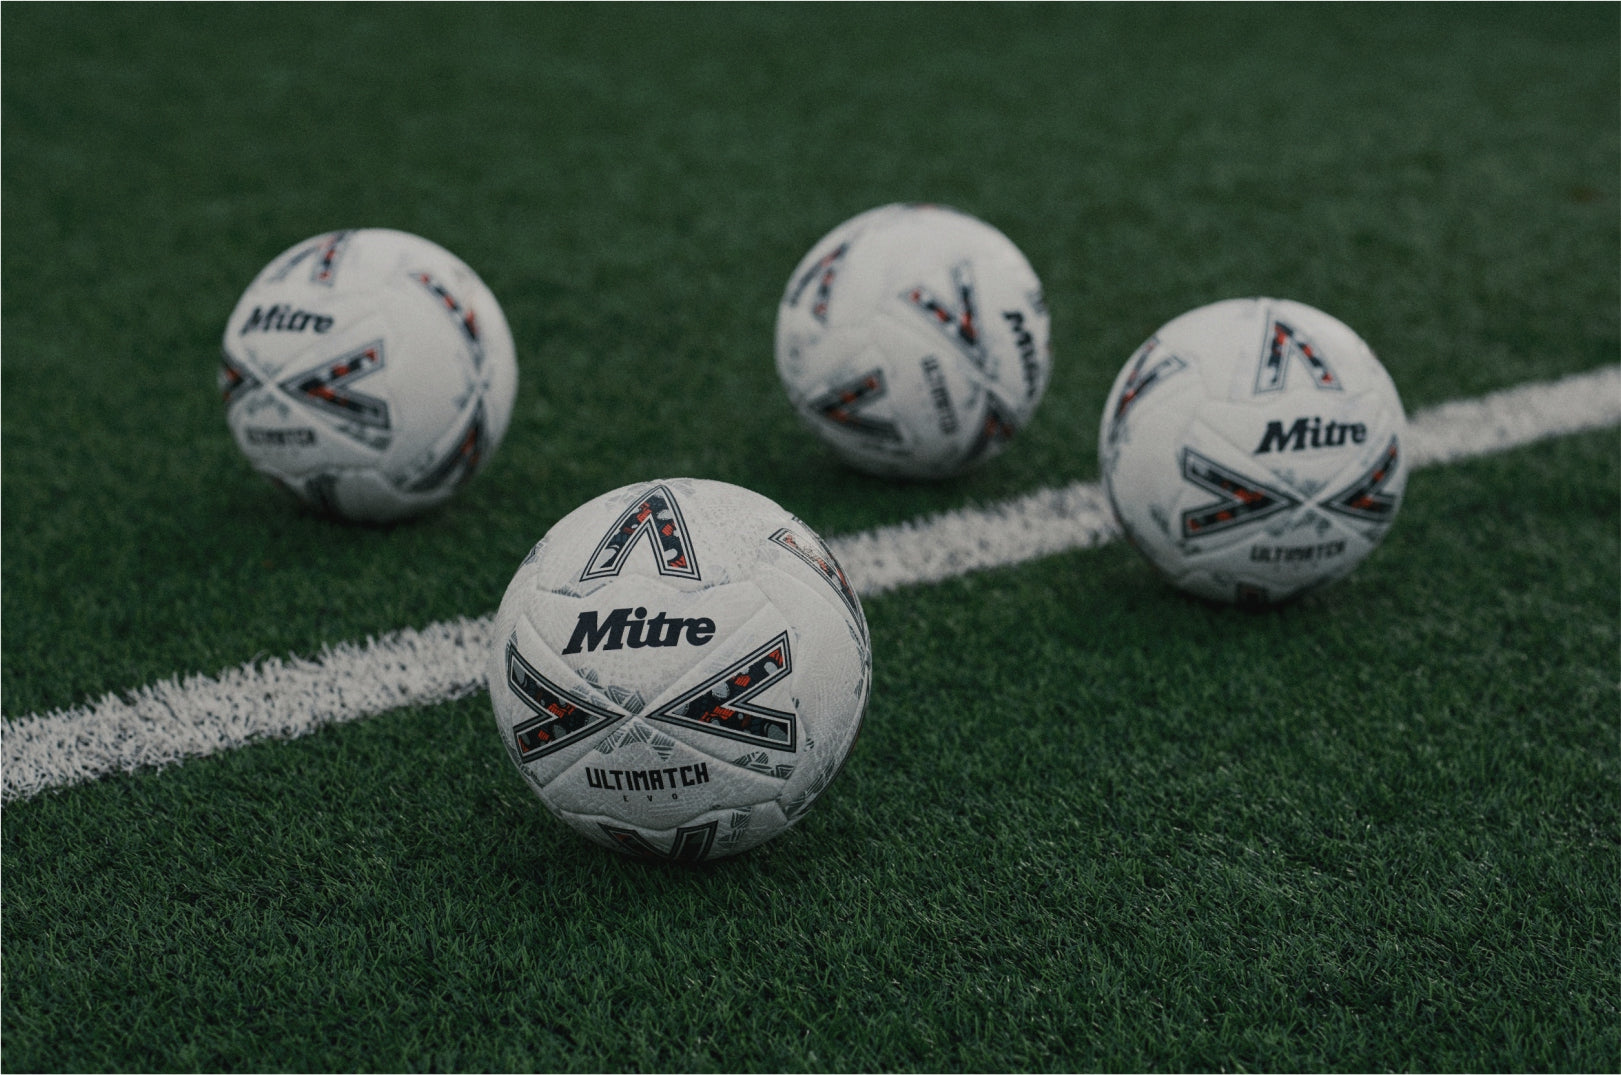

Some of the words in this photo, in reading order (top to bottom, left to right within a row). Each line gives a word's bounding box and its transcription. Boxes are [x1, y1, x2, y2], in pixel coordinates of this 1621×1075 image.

[239, 304, 334, 335] Mitre
[1253, 417, 1366, 454] Mitre
[562, 606, 716, 655] Mitre
[585, 762, 709, 791] ULTIMATCH
